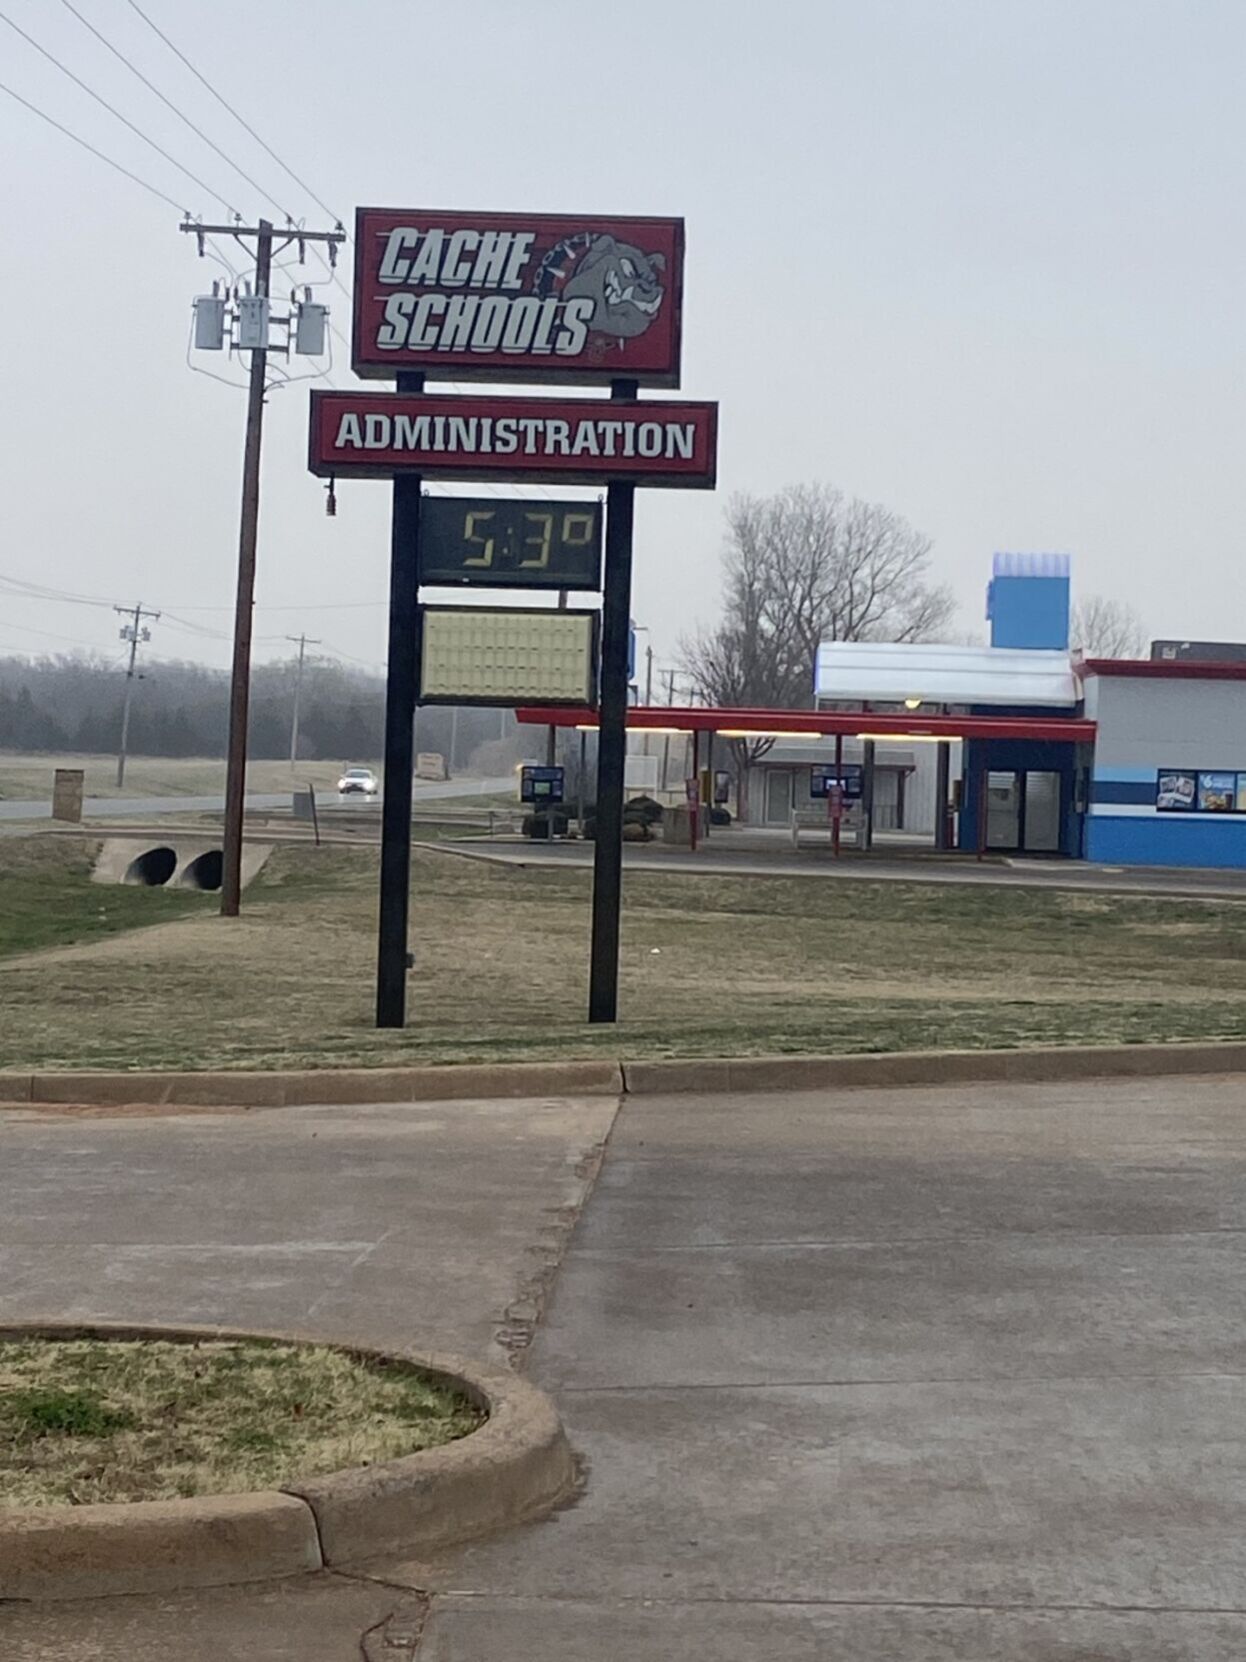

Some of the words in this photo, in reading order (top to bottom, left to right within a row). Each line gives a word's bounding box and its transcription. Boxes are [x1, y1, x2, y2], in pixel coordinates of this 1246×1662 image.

[377, 227, 535, 288] CACHE
[376, 293, 595, 356] SCHOOLS
[335, 413, 695, 458] ADMINISTRATION
